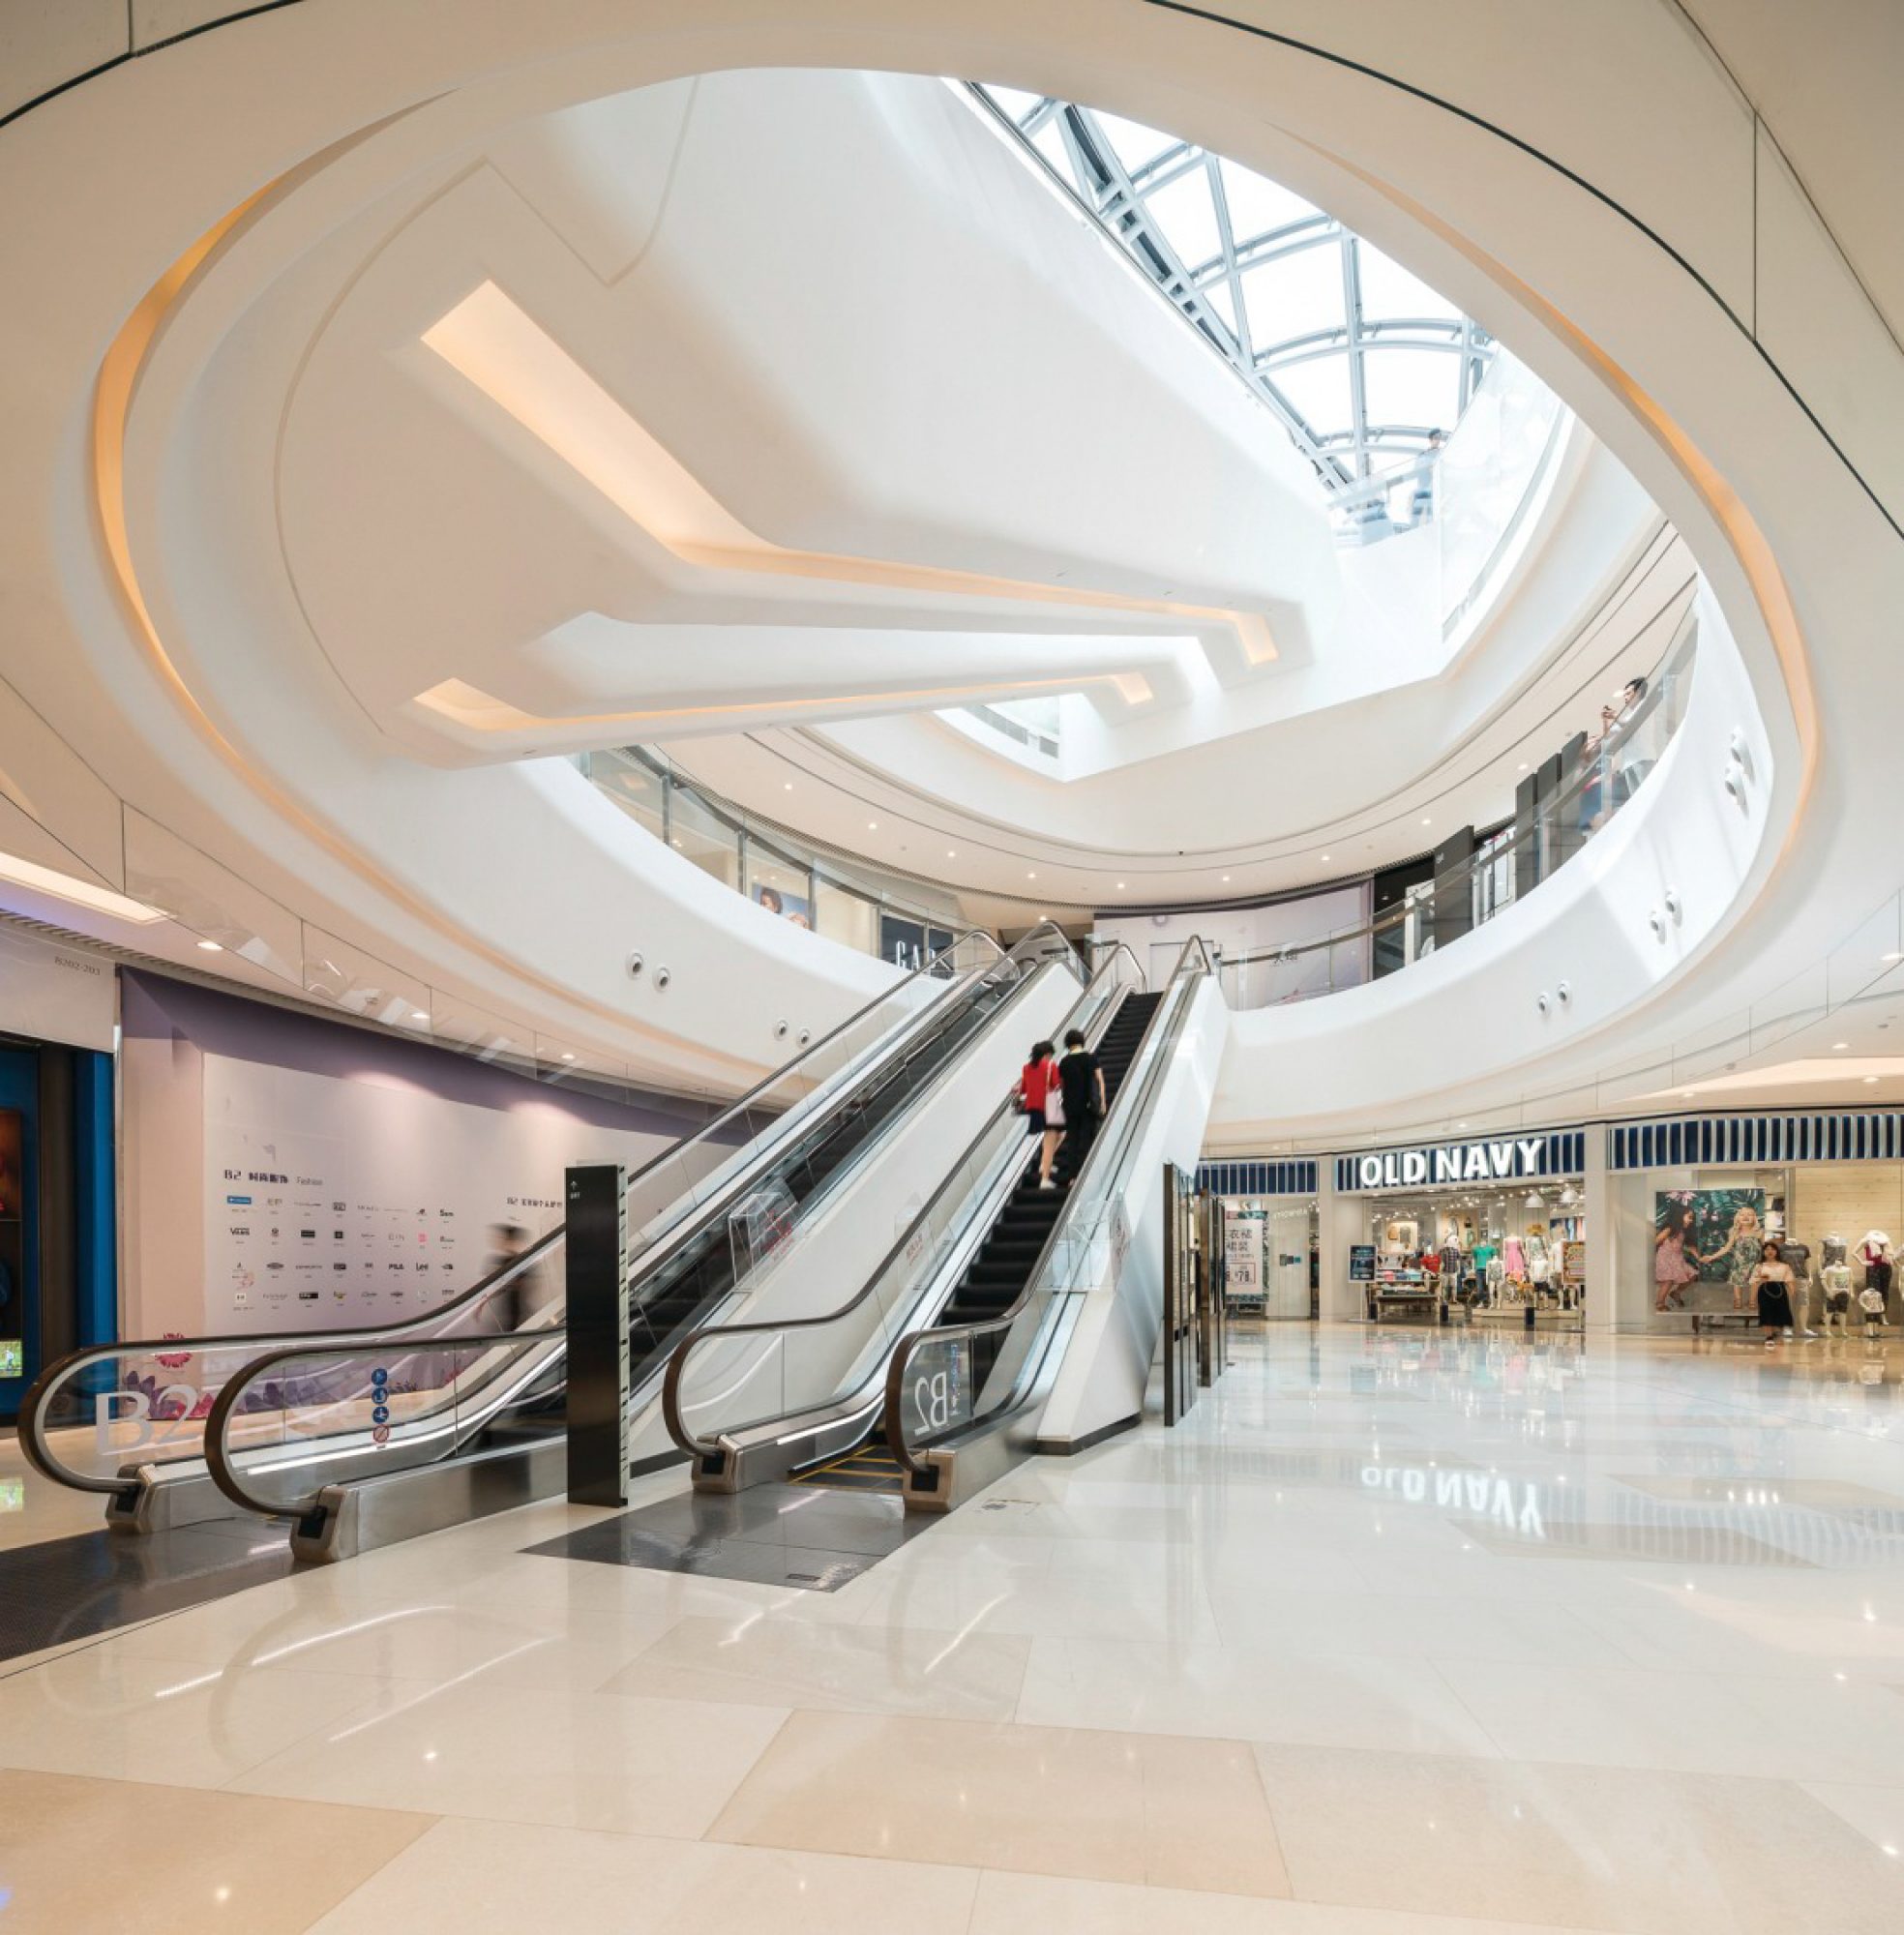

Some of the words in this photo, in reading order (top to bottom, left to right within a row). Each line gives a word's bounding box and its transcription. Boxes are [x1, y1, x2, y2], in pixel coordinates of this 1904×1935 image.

[1360, 1152, 1426, 1186] OLD
[1436, 1139, 1545, 1180] NAVY
[95, 1384, 202, 1455] B2
